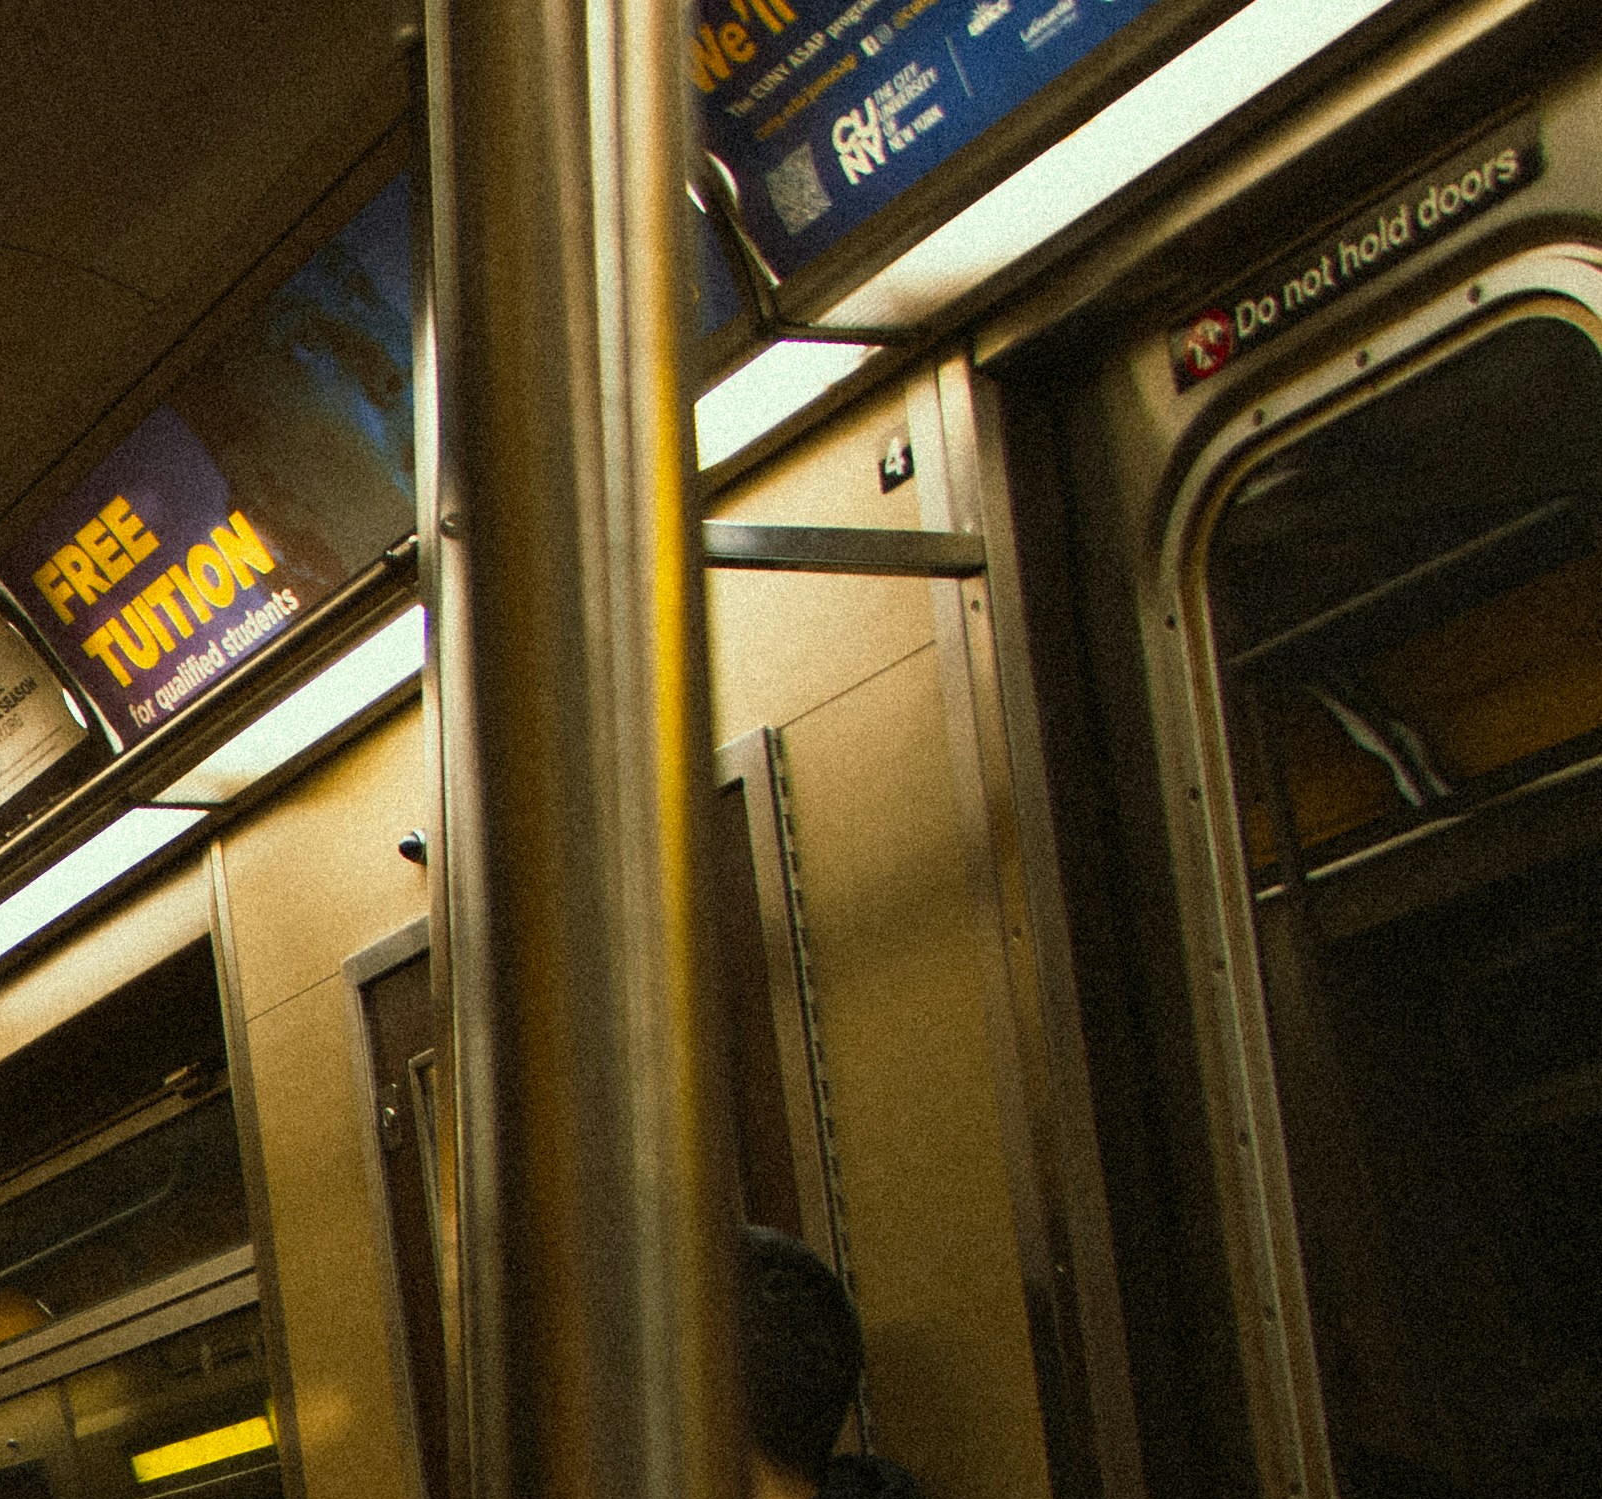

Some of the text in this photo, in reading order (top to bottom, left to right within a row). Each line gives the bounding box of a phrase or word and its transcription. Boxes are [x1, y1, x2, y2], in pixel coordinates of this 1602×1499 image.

[749, 62, 791, 100] CUNY
[786, 31, 827, 69] ASAP
[1235, 147, 1522, 341] Do not hold doors
[884, 436, 907, 477] 4
[31, 495, 161, 627] FREE
[80, 508, 277, 689] TUITION
[128, 587, 299, 729] for qualified students
